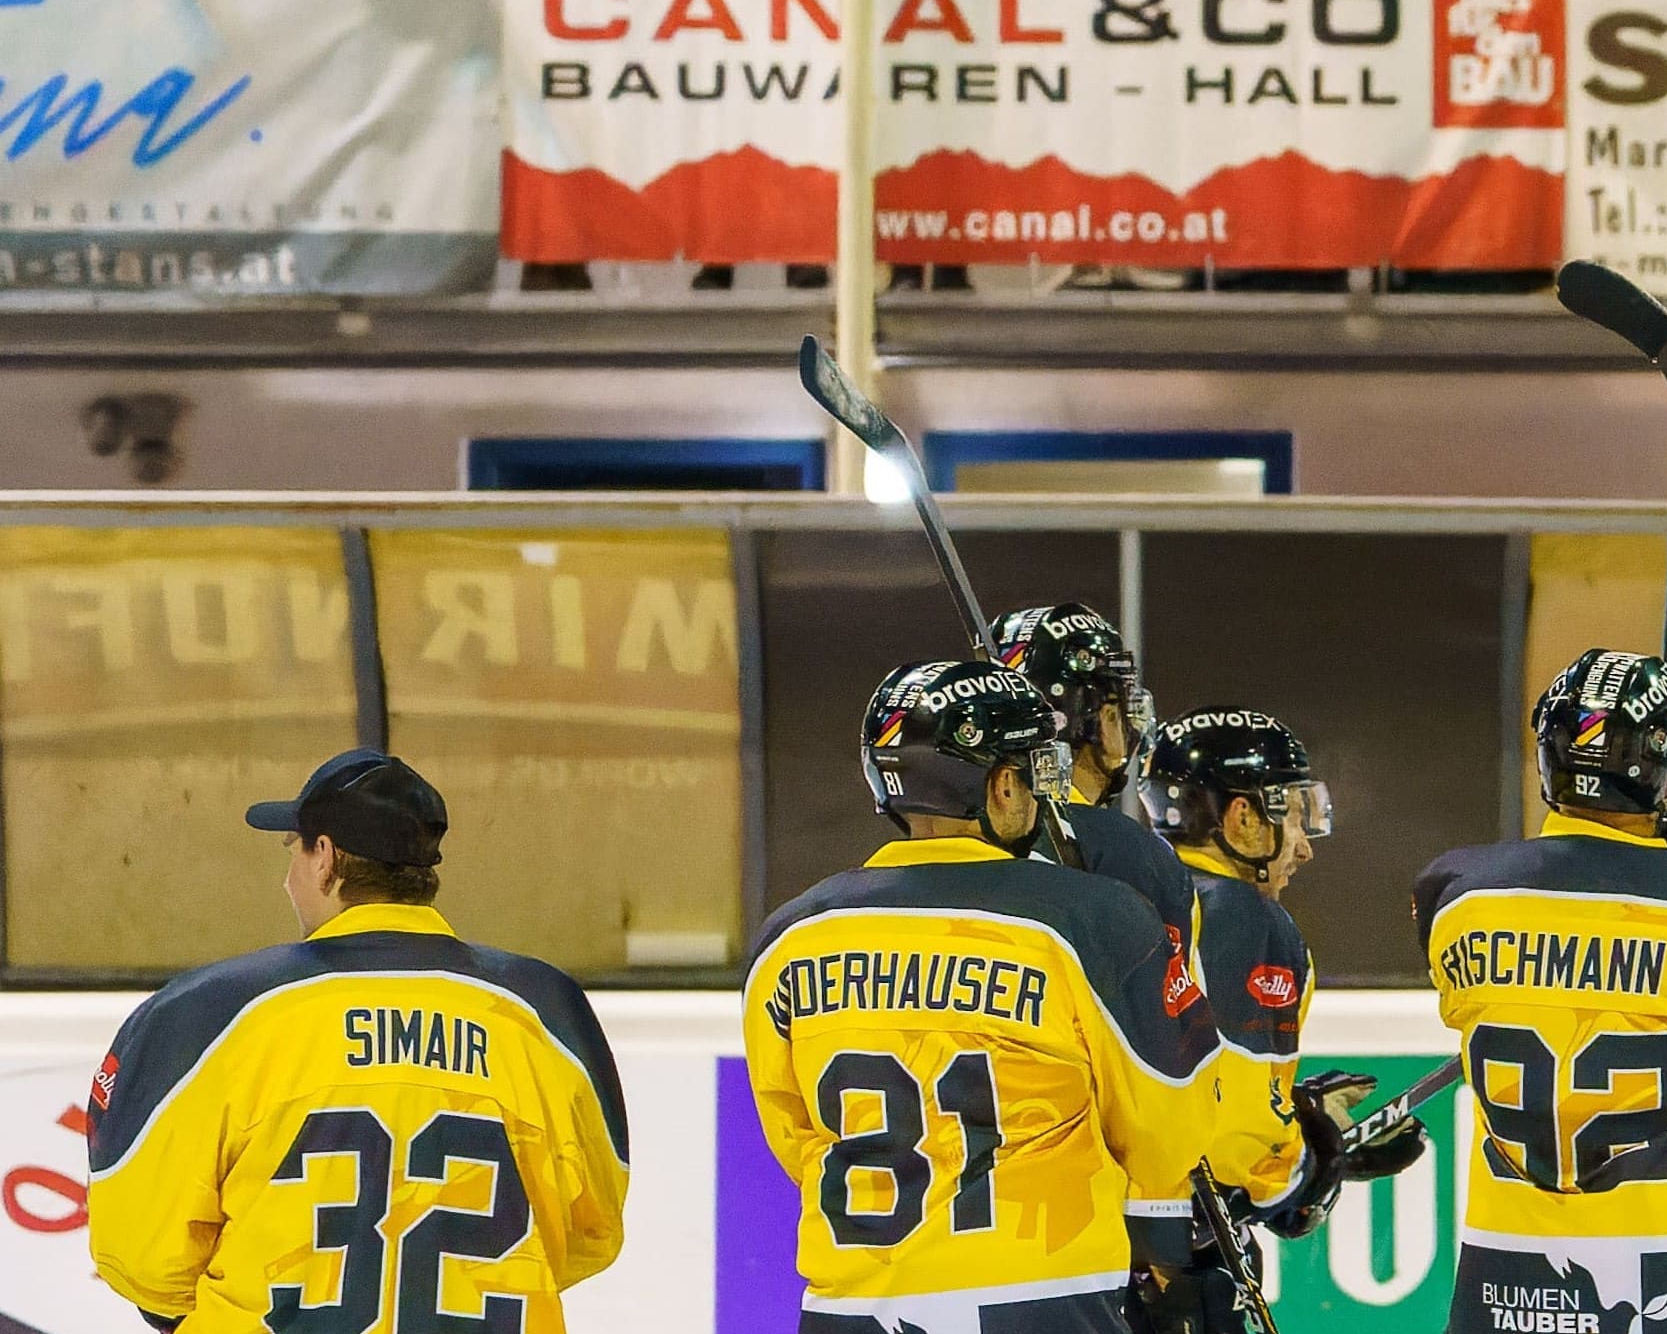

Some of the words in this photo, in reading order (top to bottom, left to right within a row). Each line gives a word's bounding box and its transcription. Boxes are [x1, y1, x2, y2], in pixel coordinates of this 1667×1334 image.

[1185, 65, 1400, 105] HALL
[1588, 187, 1667, 237] Tel.:
[1165, 709, 1283, 741] bravoTEX
[881, 770, 905, 797] 81
[1574, 773, 1601, 798] 92
[343, 1007, 490, 1079] SIMAIR
[815, 1049, 1005, 1250] 81
[1481, 1280, 1581, 1313] BLUMEN
